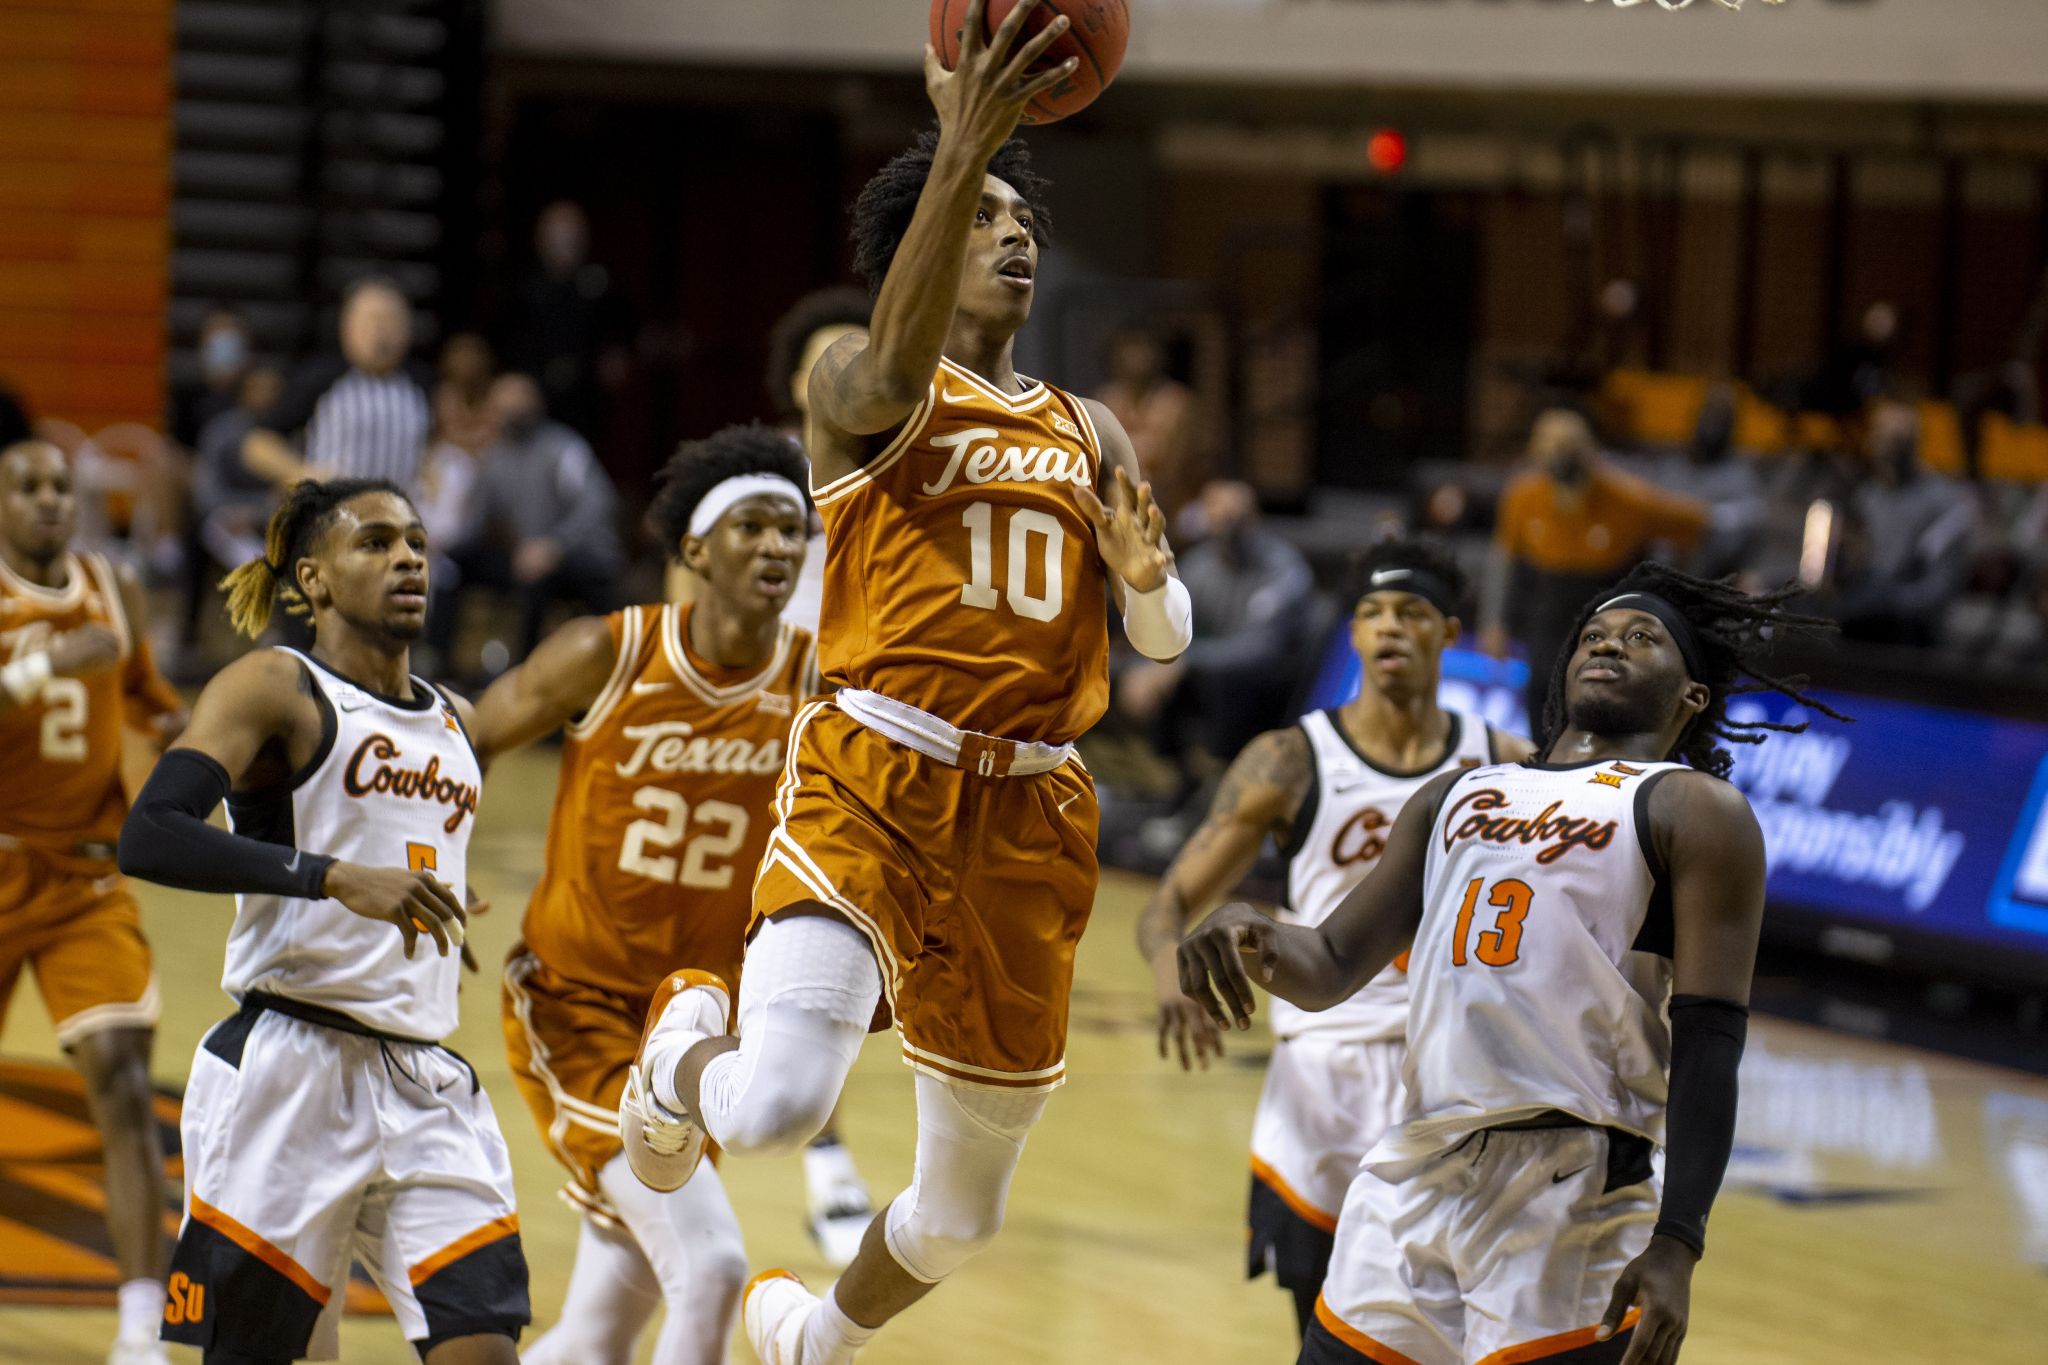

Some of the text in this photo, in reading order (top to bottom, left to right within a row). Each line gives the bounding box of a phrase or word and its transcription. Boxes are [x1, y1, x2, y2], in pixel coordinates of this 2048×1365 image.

[922, 427, 1092, 496] Texas
[960, 501, 1065, 623] 10
[41, 677, 87, 763] 2
[614, 720, 786, 778] Texas
[343, 731, 478, 835] Cowboys
[1444, 788, 1619, 865] Cowboys
[617, 785, 750, 891] 22
[1452, 876, 1535, 967] 13
